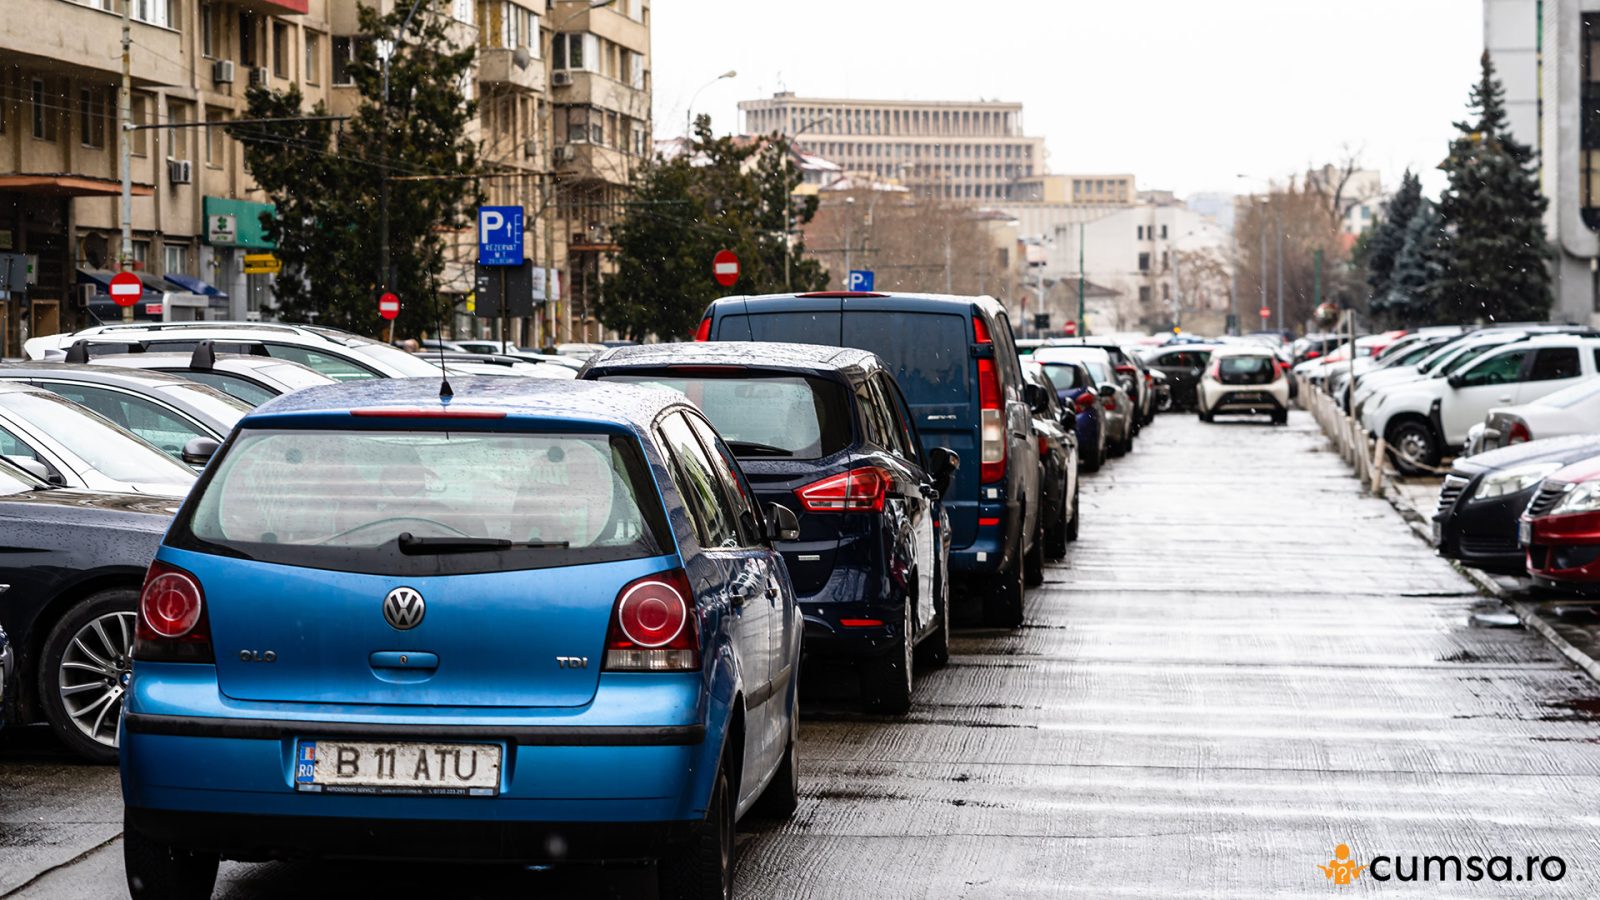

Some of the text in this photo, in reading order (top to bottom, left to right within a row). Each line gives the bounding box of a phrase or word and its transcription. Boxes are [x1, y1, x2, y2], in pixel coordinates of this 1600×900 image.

[481, 211, 504, 244] P
[851, 273, 863, 290] P
[556, 656, 588, 669] TDI
[298, 764, 314, 777] RO
[336, 747, 477, 781] B 11 ATU
